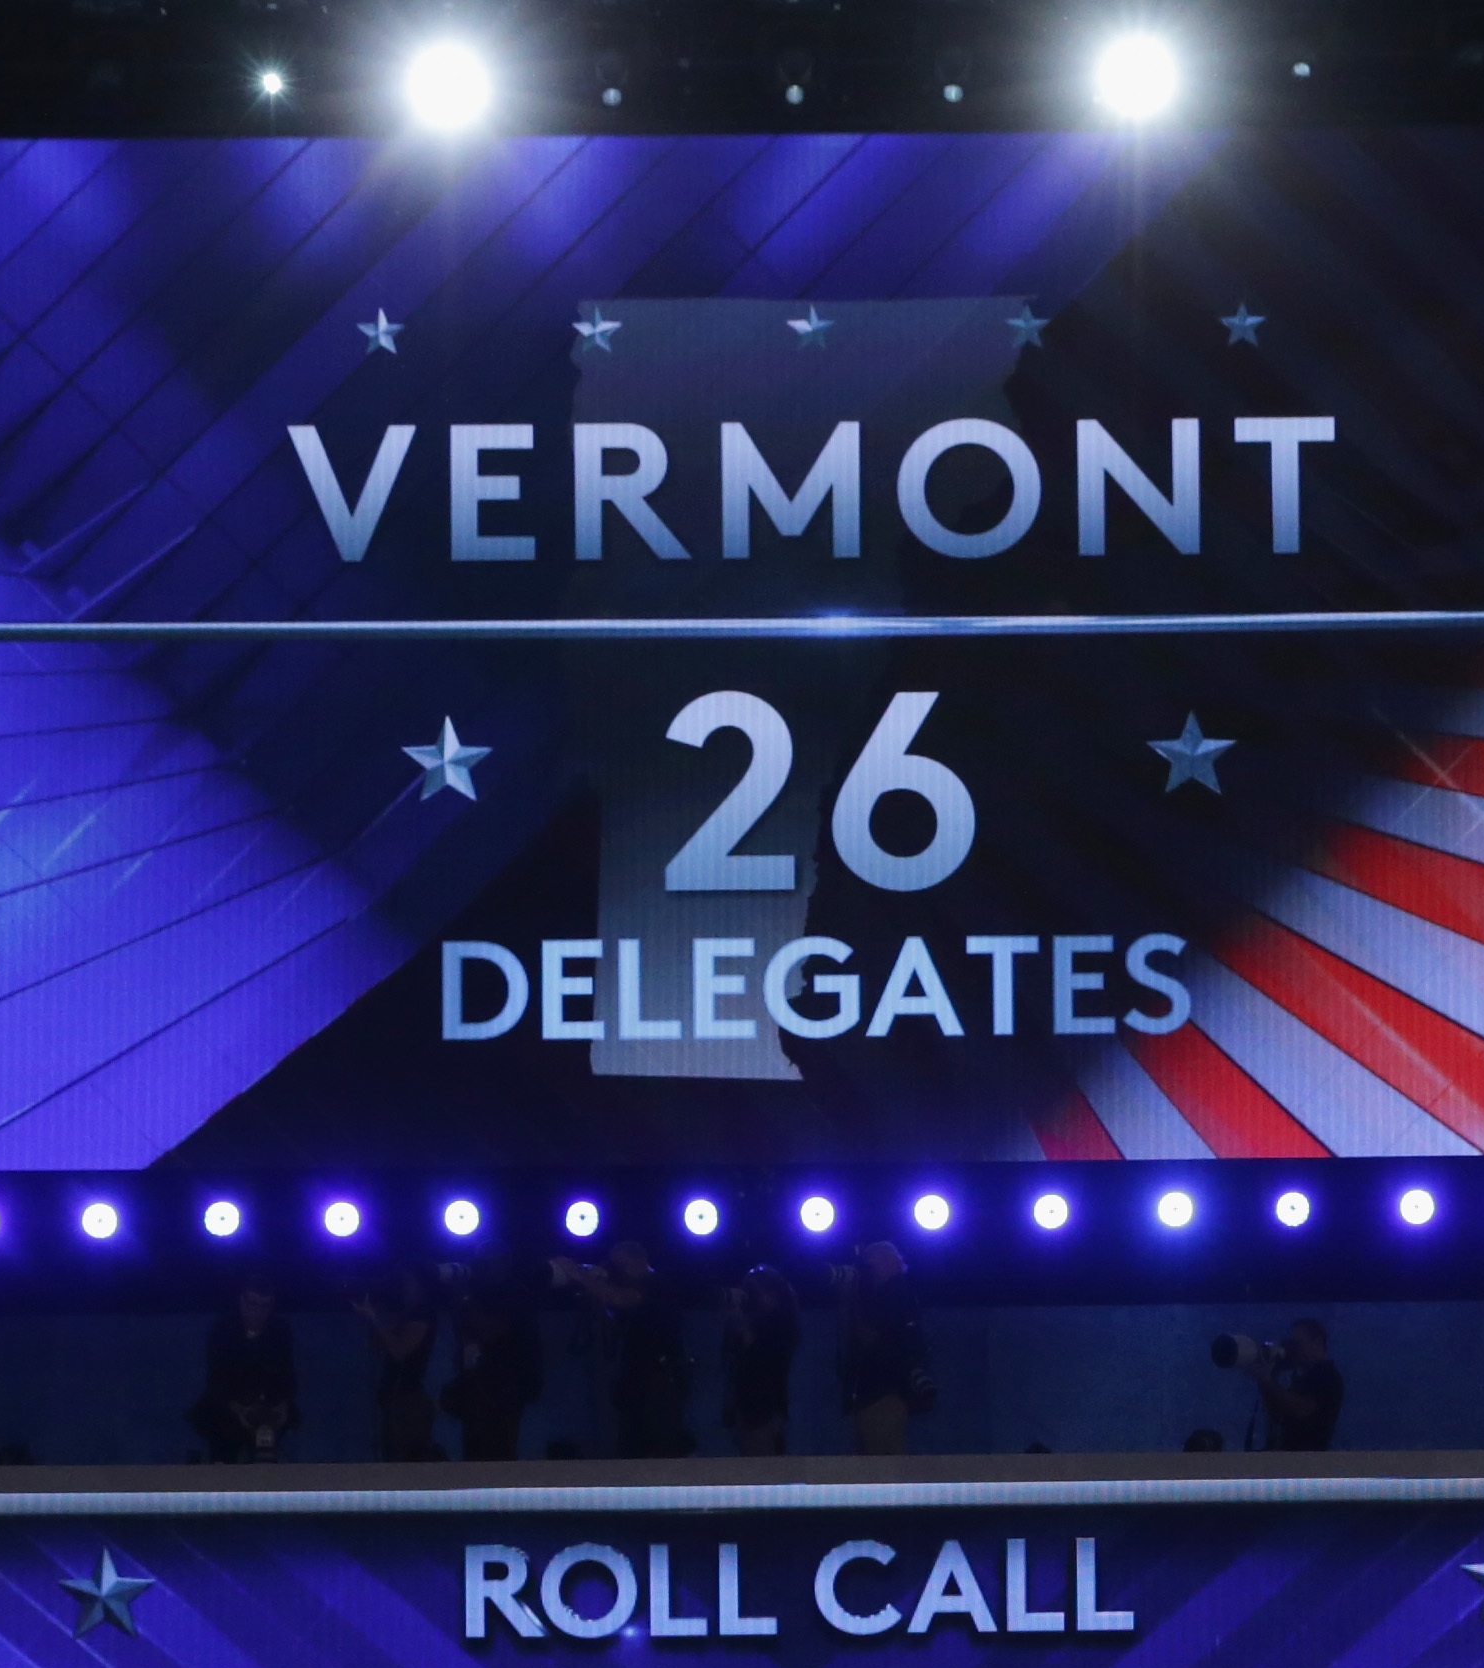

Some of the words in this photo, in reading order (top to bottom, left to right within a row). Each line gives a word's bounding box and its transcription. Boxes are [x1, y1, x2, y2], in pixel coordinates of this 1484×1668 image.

[286, 416, 1335, 562] VERMONT
[664, 689, 975, 892] 26
[441, 932, 1194, 1040] DELEGATES
[465, 1542, 778, 1639] ROLL
[814, 1537, 1135, 1636] CALL
